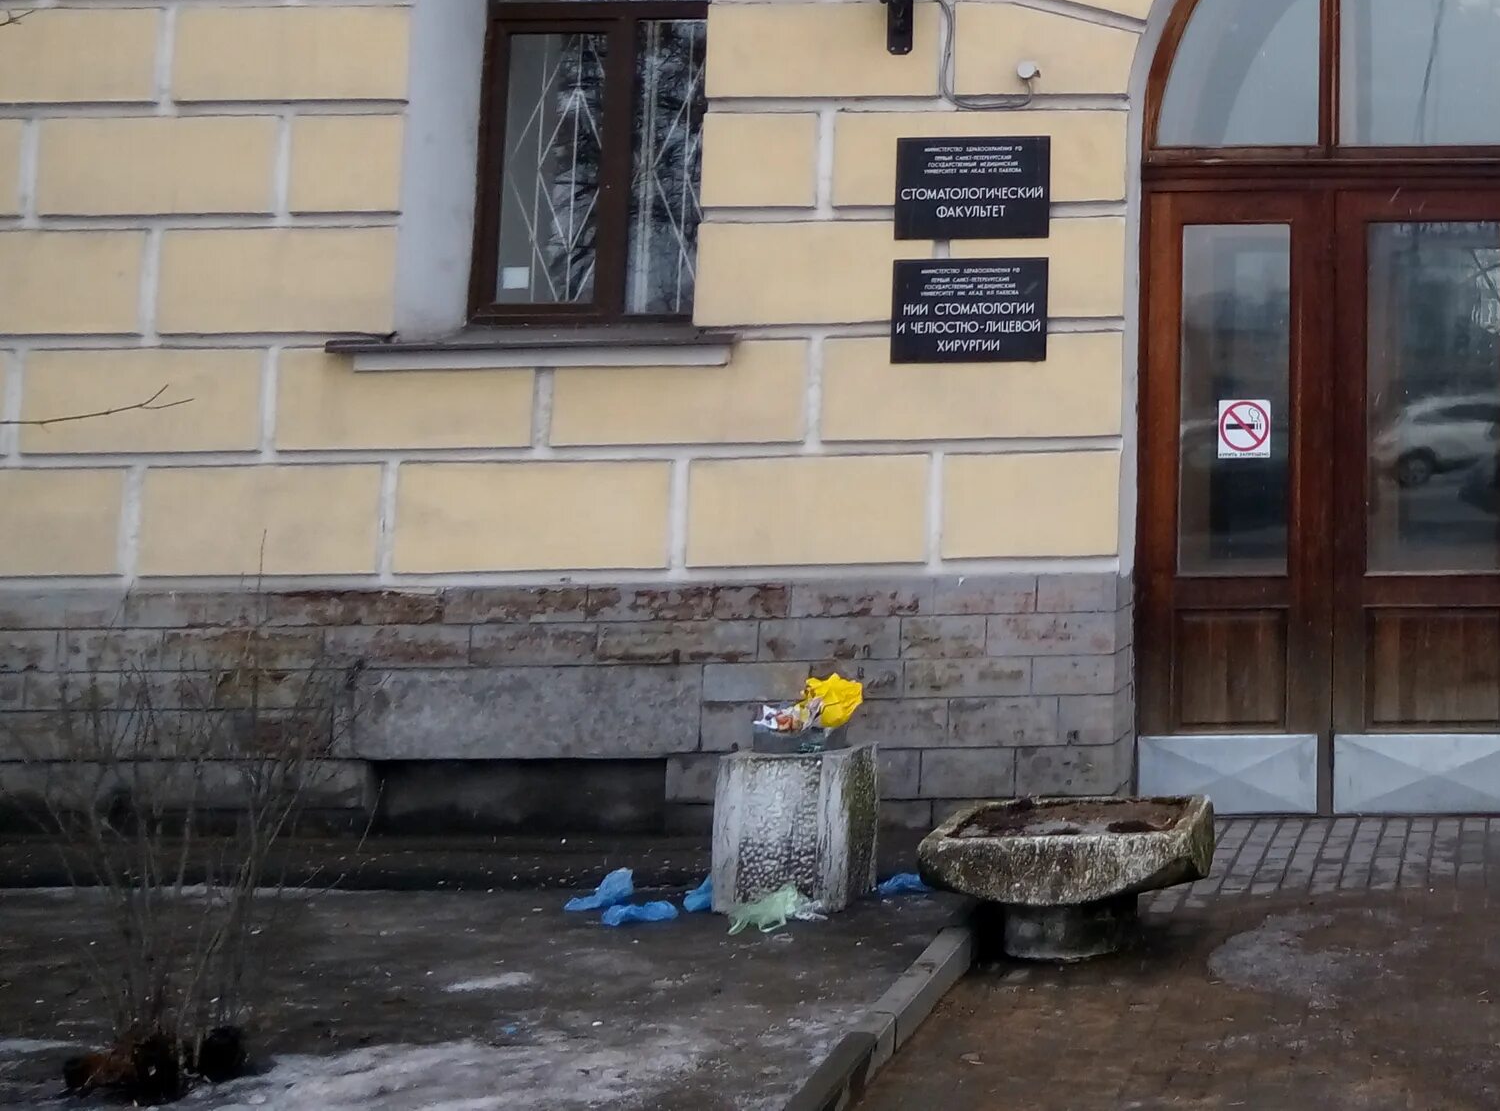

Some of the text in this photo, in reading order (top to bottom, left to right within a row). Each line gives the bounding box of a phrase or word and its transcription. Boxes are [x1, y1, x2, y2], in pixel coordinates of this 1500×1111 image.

[901, 186, 1044, 200] СТОМАТОЛОГИЧЕСКИЙ
[936, 205, 1006, 218] ФАКУЛЬТЕТ
[903, 302, 1035, 316] НИИ СТОМАТОЛОГИИ
[896, 319, 1041, 334] И ЧЕЛЮСТНО-ЛИЦЕВОЙ
[937, 339, 1000, 352] ХИРУРГИИ
